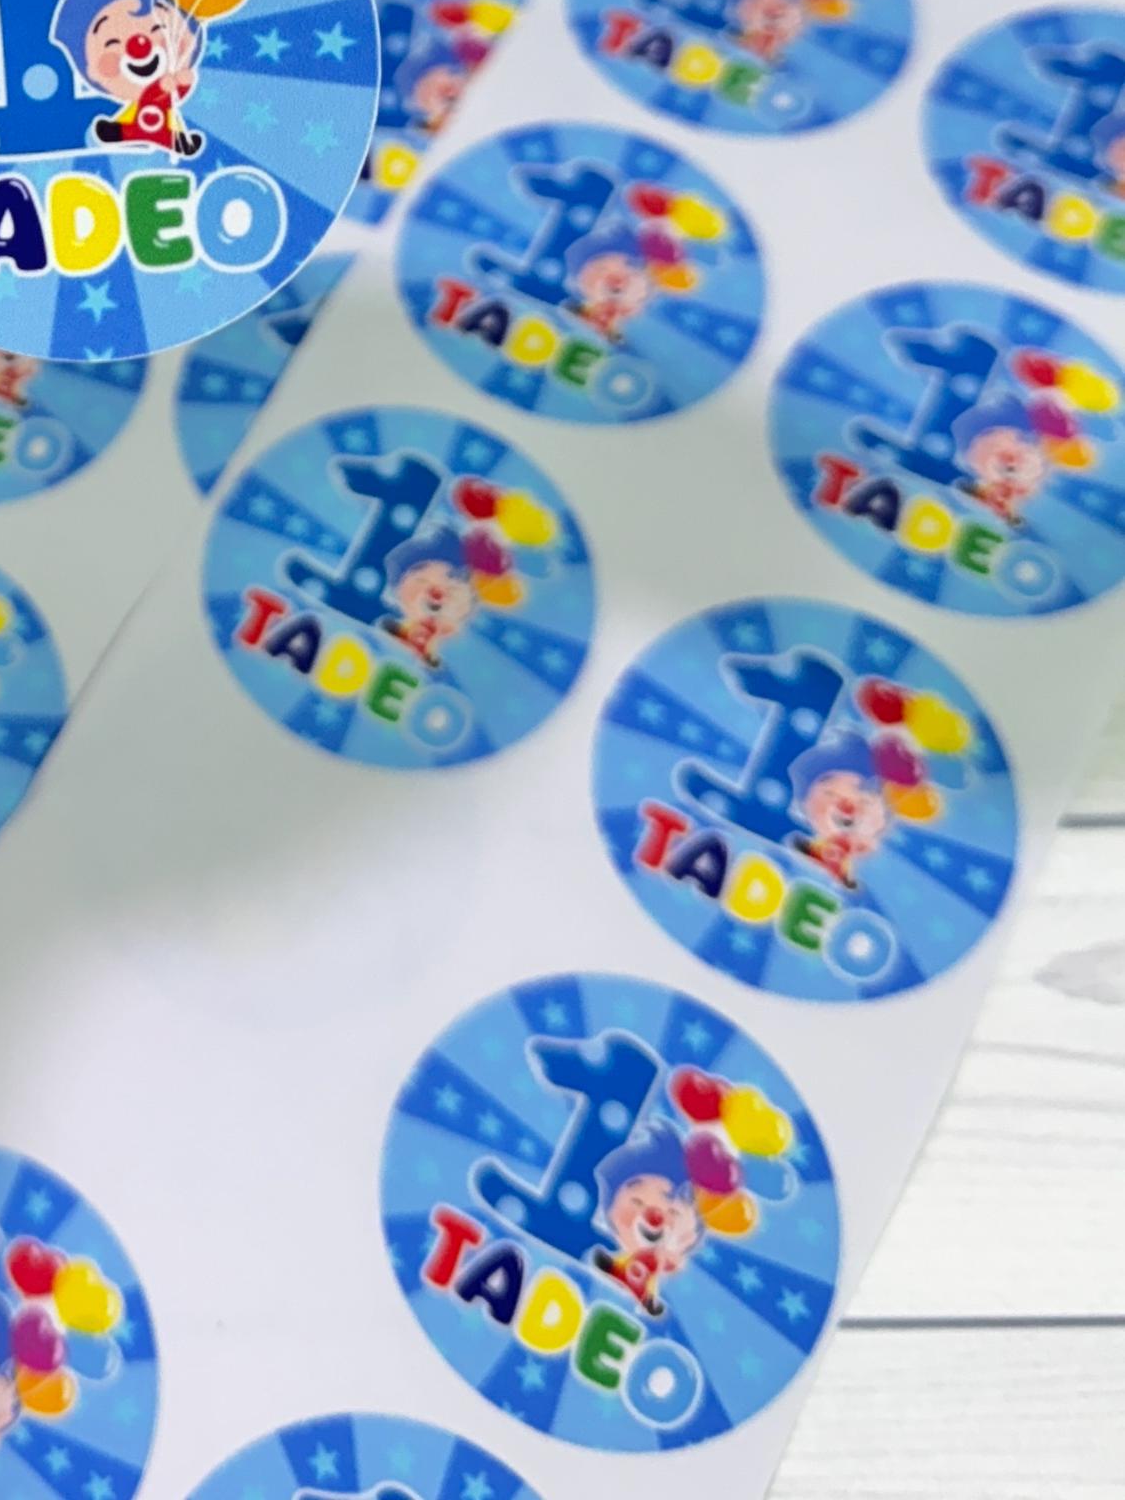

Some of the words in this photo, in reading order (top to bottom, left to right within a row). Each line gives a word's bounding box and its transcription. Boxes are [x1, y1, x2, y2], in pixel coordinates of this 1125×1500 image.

[597, 8, 817, 122] TADEO
[467, 162, 617, 308] 1
[965, 154, 1125, 264] TADE
[428, 276, 655, 408] TADEO
[845, 324, 1001, 487] 1
[280, 450, 443, 626] 1
[809, 450, 1062, 606] TADEO
[235, 587, 473, 752] TADEO
[672, 647, 846, 846] 1
[634, 797, 898, 984] TADEO
[470, 1028, 665, 1265] 1
[420, 1202, 703, 1430] TADEO
